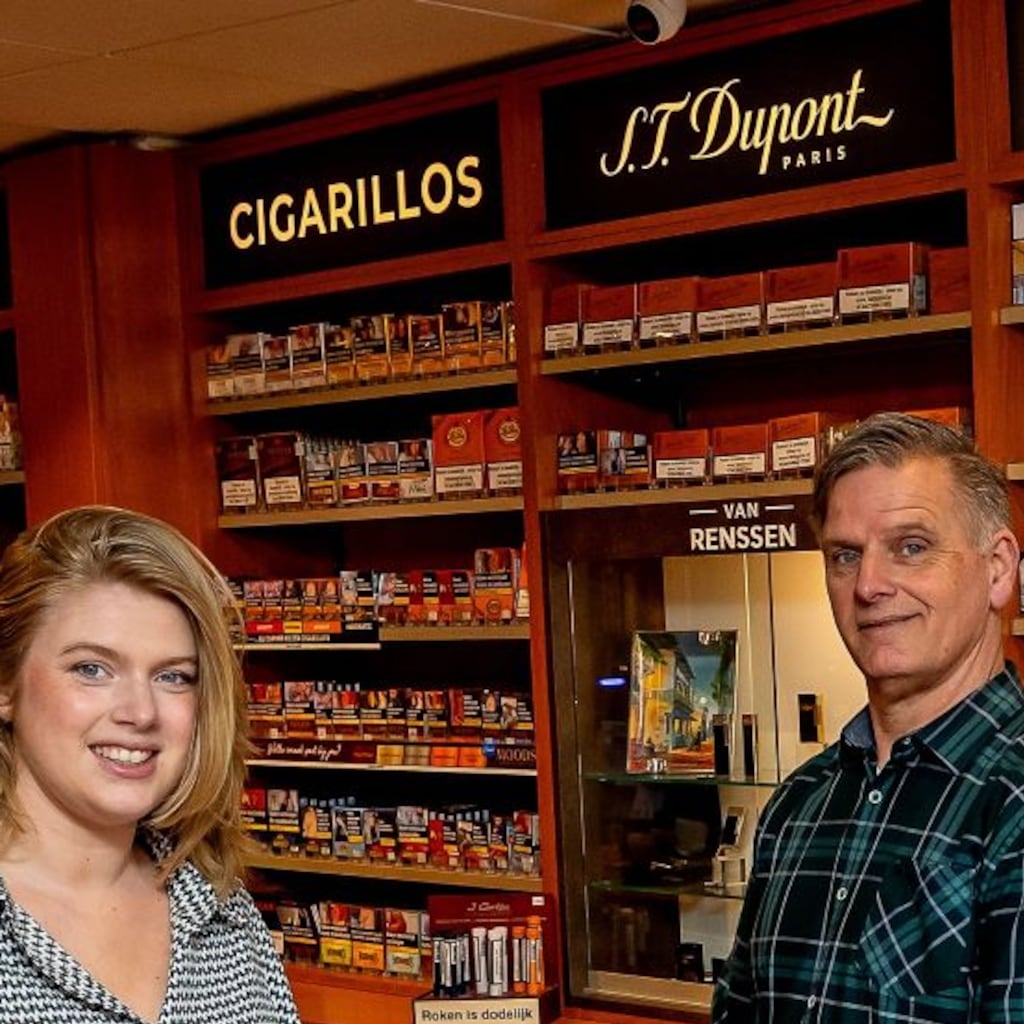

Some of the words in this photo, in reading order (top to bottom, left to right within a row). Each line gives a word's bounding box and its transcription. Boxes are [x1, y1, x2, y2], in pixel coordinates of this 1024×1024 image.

[689, 69, 894, 175] Dupont
[782, 144, 848, 171] PARIS
[229, 155, 485, 250] CIGARILLOS
[723, 502, 759, 519] VAN
[690, 523, 797, 551] RENSSEN
[422, 1009, 463, 1022] Roken
[466, 1009, 478, 1020] is
[482, 1007, 533, 1023] dodelijk
